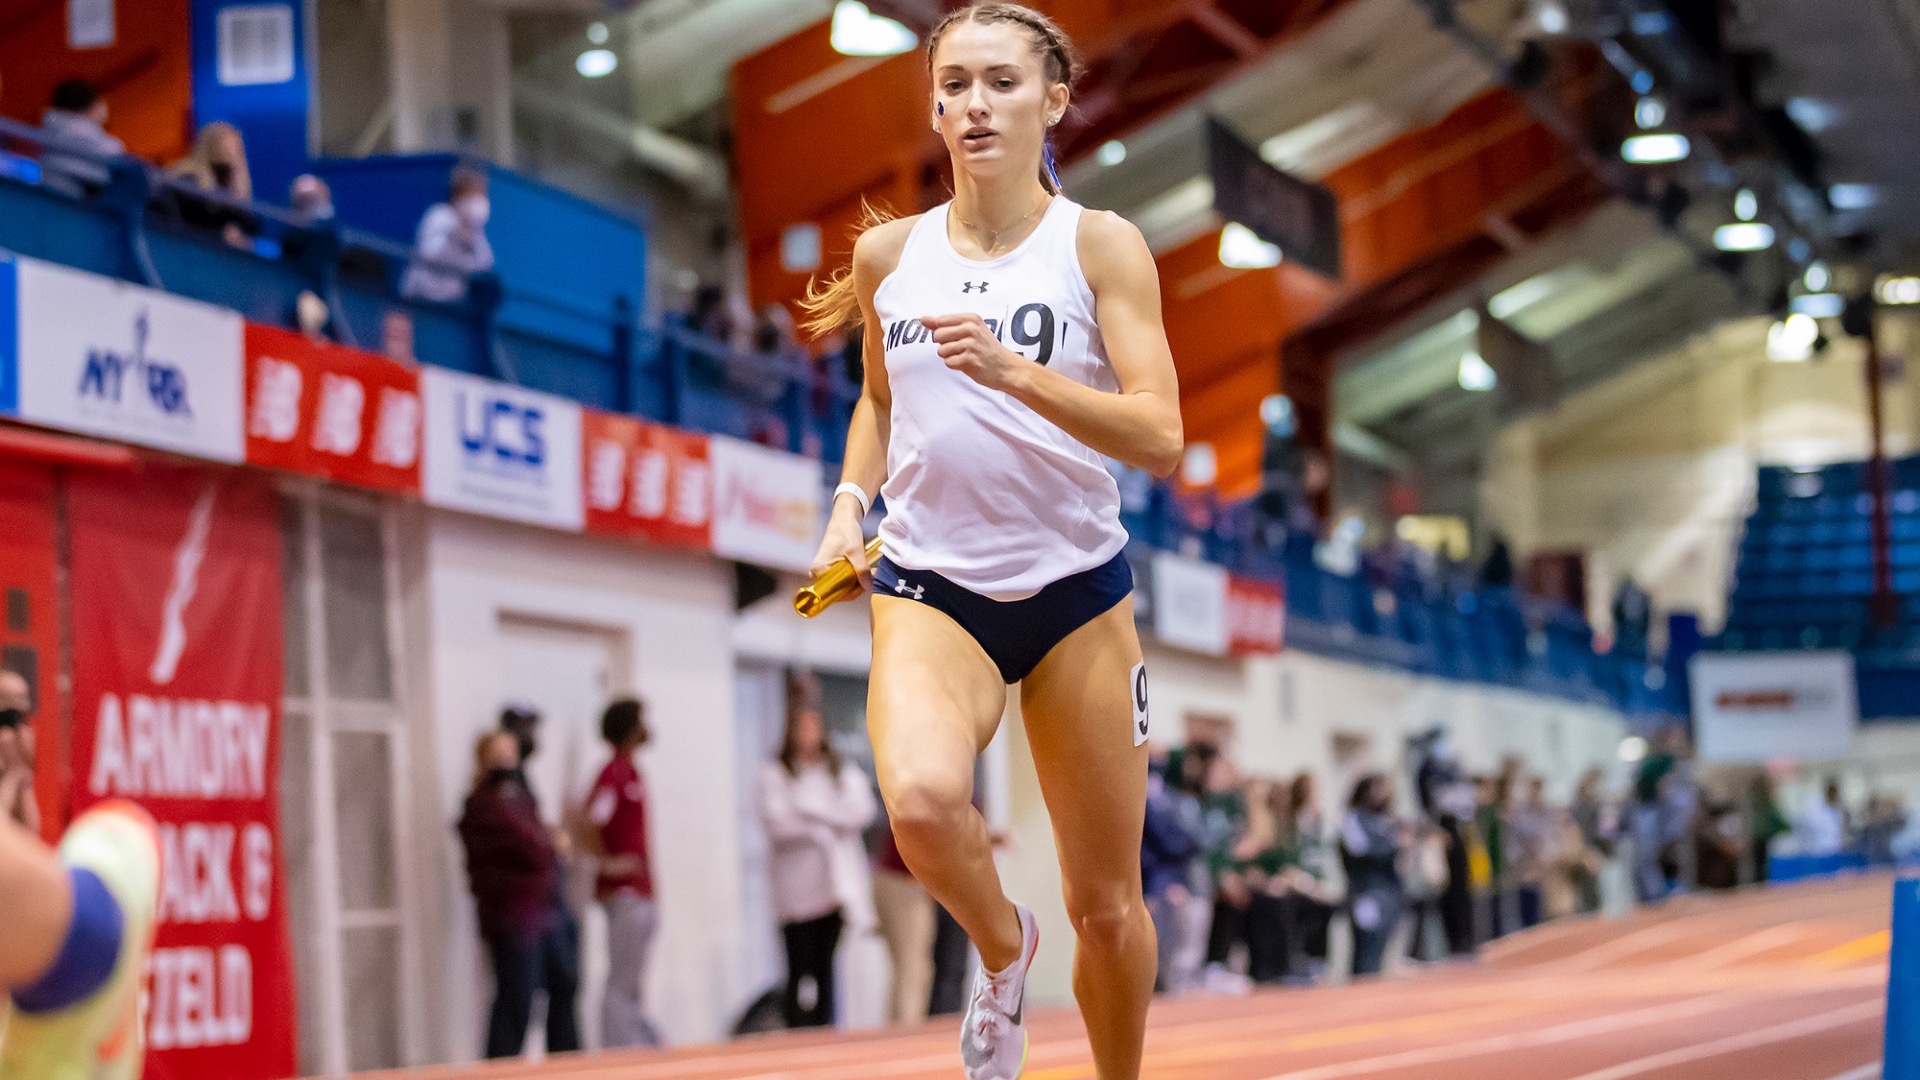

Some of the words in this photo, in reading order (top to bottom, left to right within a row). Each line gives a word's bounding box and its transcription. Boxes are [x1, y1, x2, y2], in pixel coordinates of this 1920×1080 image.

[1011, 303, 1055, 367] 9
[456, 390, 546, 467] UCS
[1136, 665, 1149, 736] 9
[90, 693, 270, 798] ARMORY
[156, 821, 241, 924] ACK
